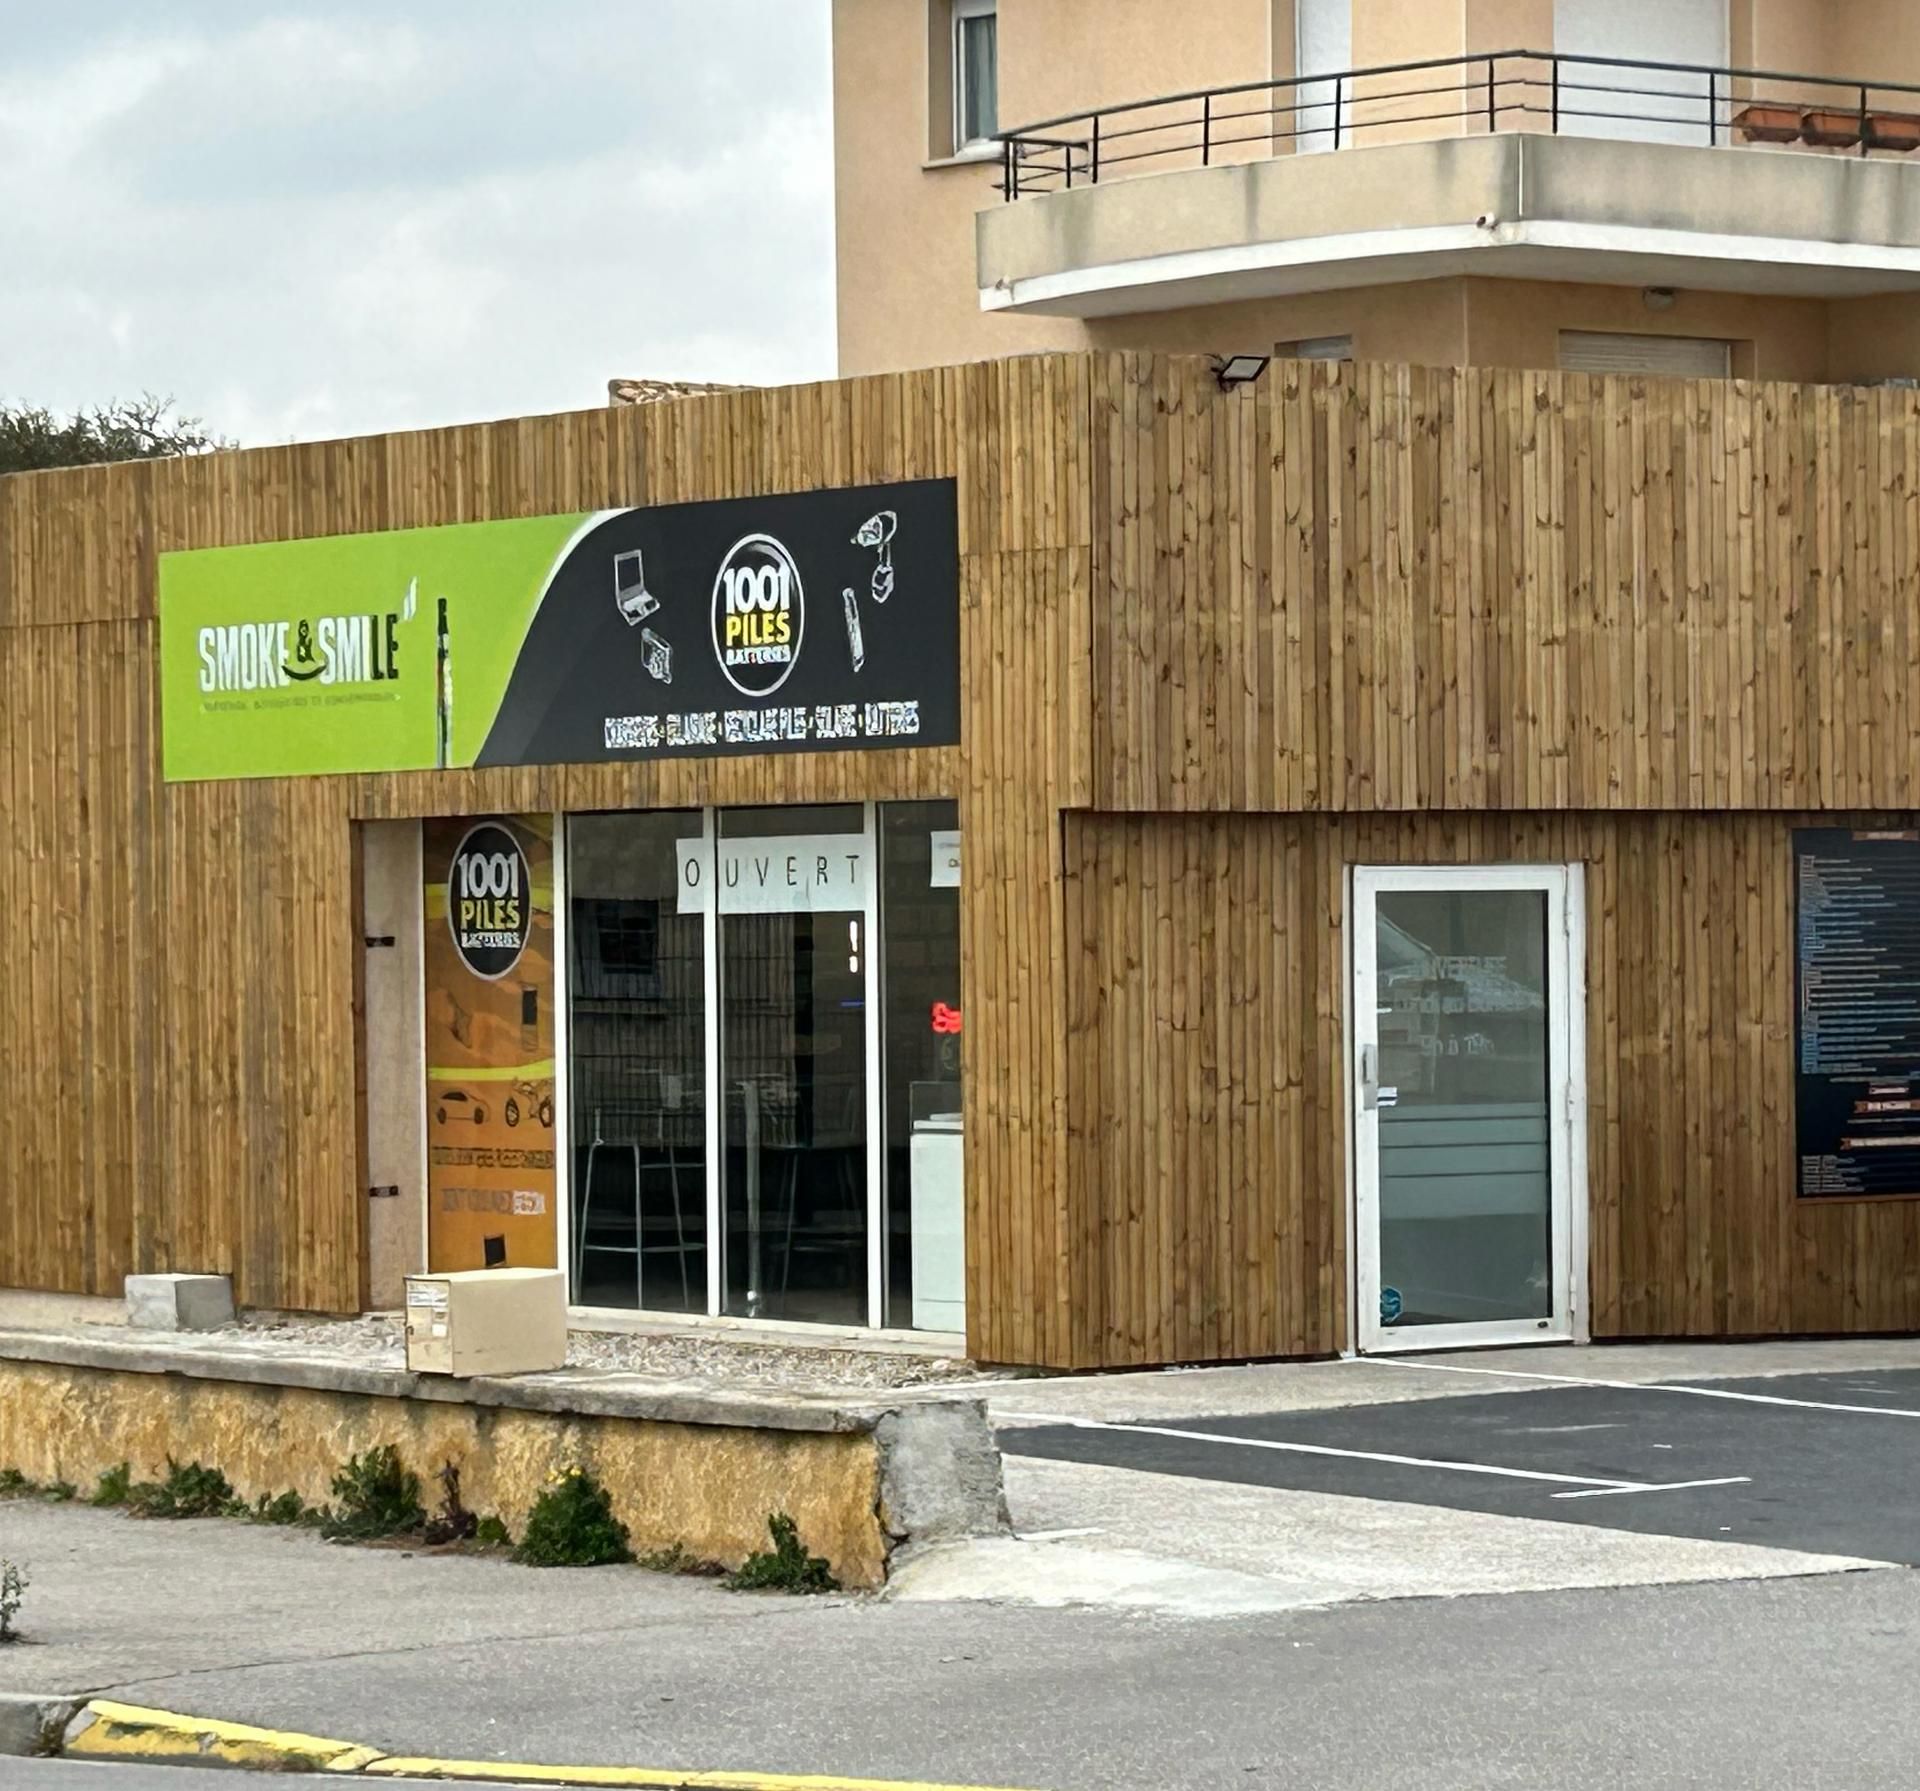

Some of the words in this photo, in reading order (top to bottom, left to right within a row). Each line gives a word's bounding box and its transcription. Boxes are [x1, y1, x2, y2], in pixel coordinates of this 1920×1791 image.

[723, 565, 790, 615] 1001
[726, 612, 791, 647] PILES
[199, 621, 289, 692] SMOKE
[318, 613, 399, 685] SMILE
[457, 852, 519, 898] 1001
[685, 854, 860, 888] OUVERT
[461, 899, 520, 930] PILES
